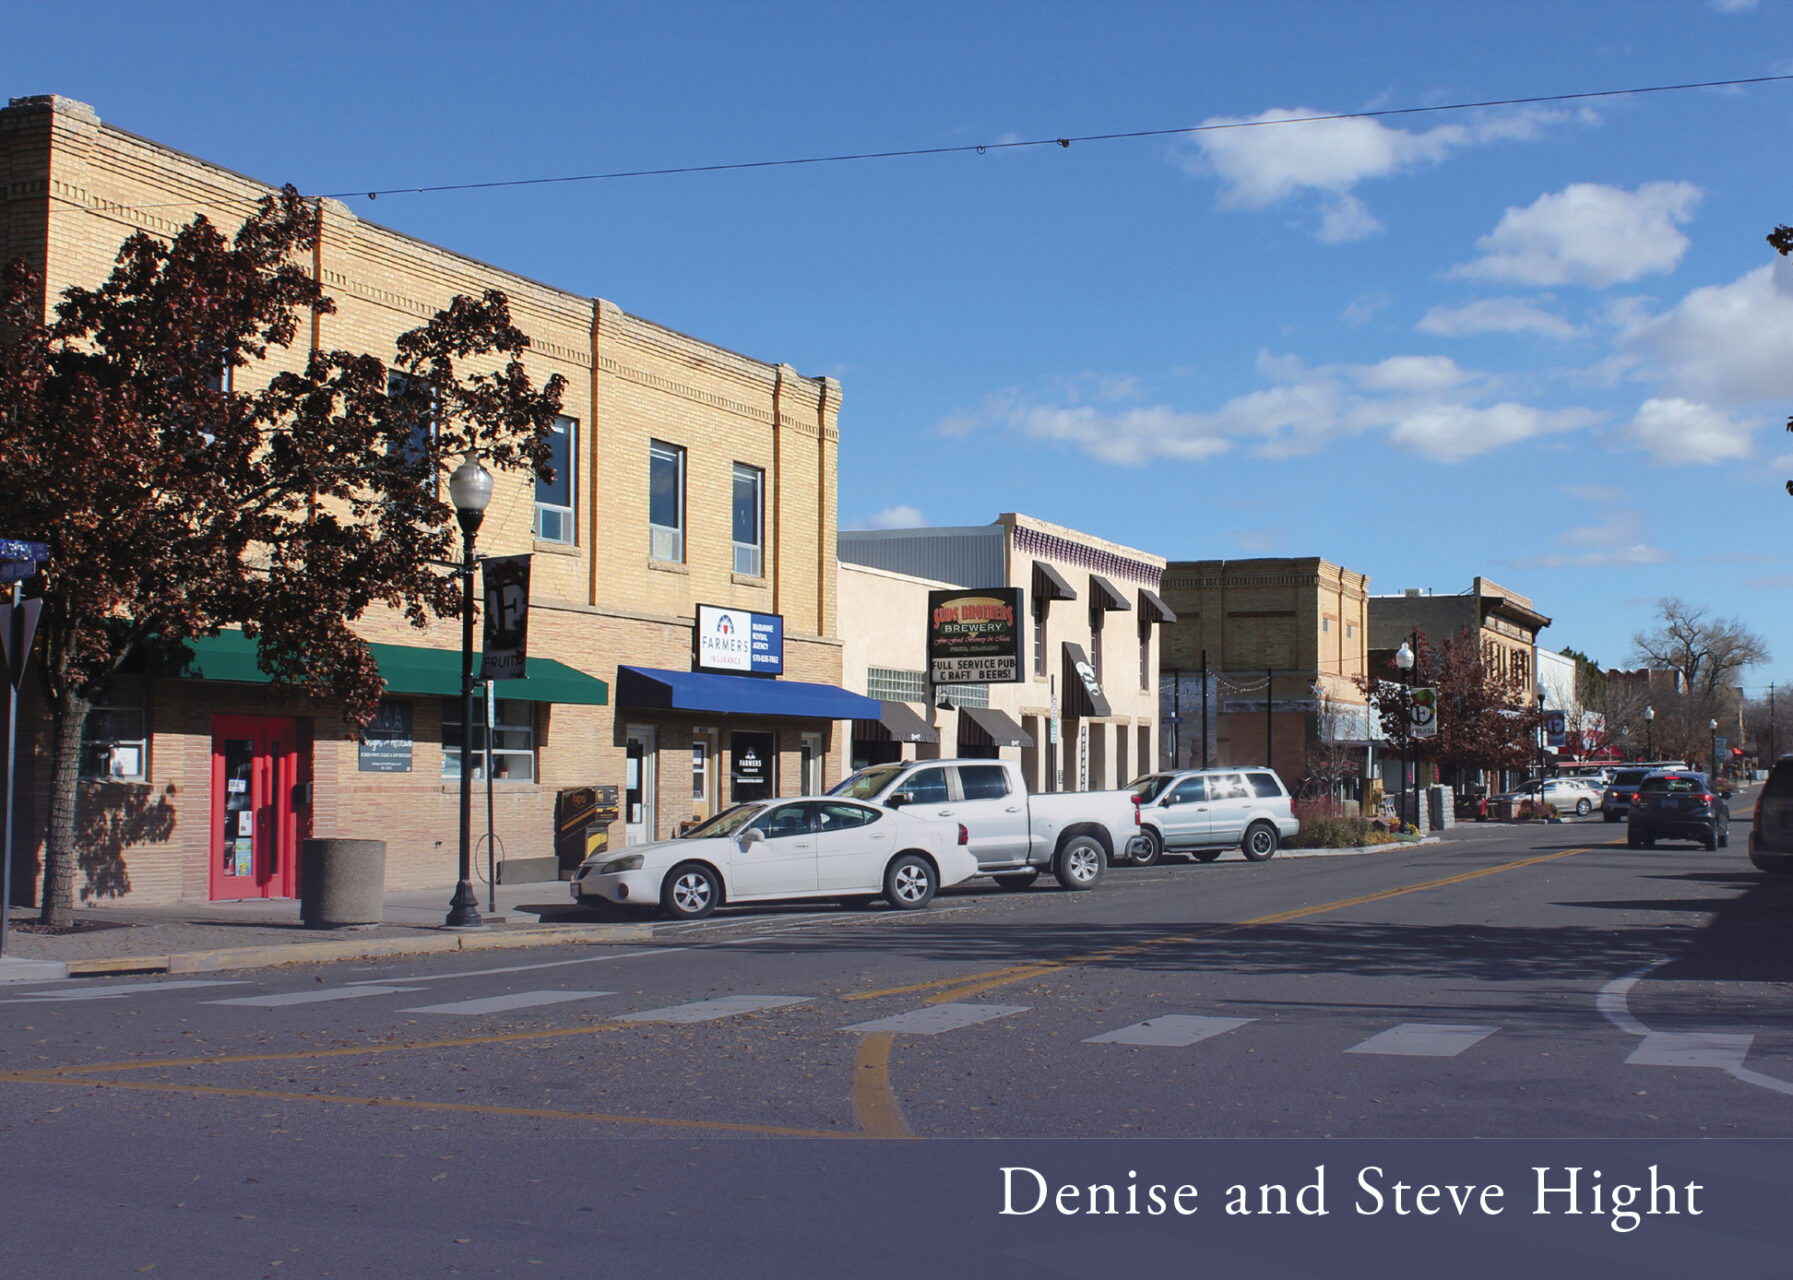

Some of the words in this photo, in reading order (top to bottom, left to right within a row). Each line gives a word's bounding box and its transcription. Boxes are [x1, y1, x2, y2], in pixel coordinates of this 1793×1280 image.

[933, 606, 959, 630] SUDS
[962, 604, 1014, 627] BROTHERS
[945, 623, 1002, 633] BREWERY
[702, 635, 749, 653] FARMERS
[710, 655, 742, 665] INSURANCE
[932, 660, 953, 670] FULL
[957, 659, 996, 670] SERVICE
[998, 658, 1016, 668] PUB
[979, 669, 1011, 680] BEERS!
[738, 759, 762, 767] FARMERS
